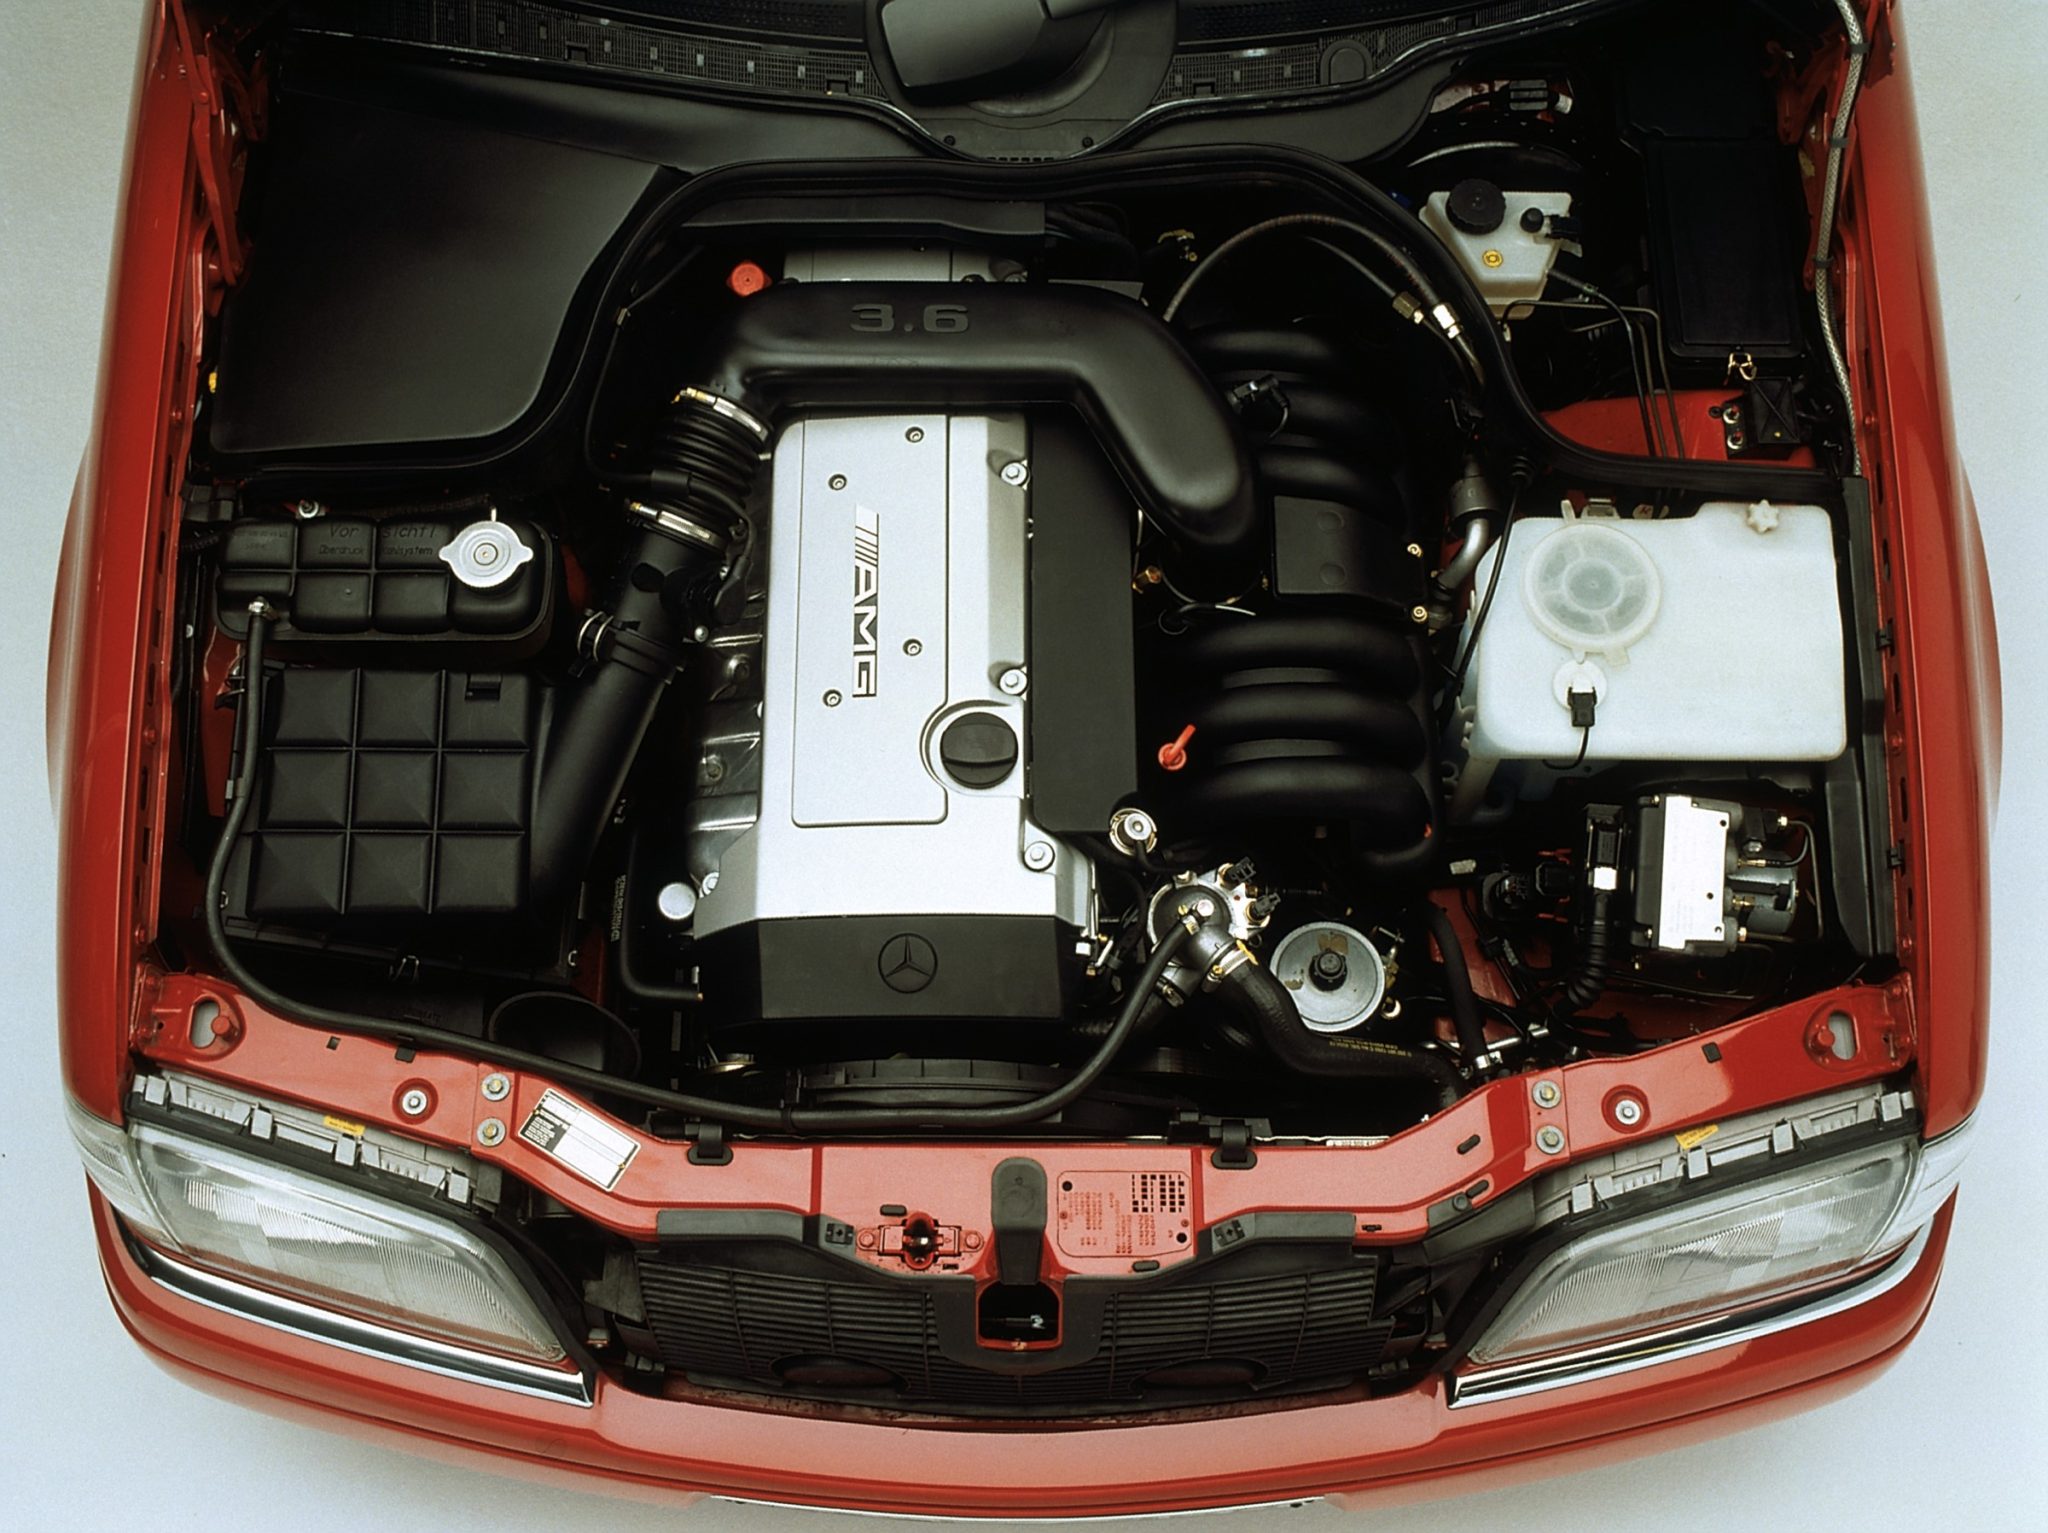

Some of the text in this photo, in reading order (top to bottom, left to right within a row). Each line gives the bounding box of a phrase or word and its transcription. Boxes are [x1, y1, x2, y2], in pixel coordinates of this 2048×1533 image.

[850, 304, 968, 332] 3.6
[331, 523, 360, 538] Vor
[853, 558, 878, 697] AMG
